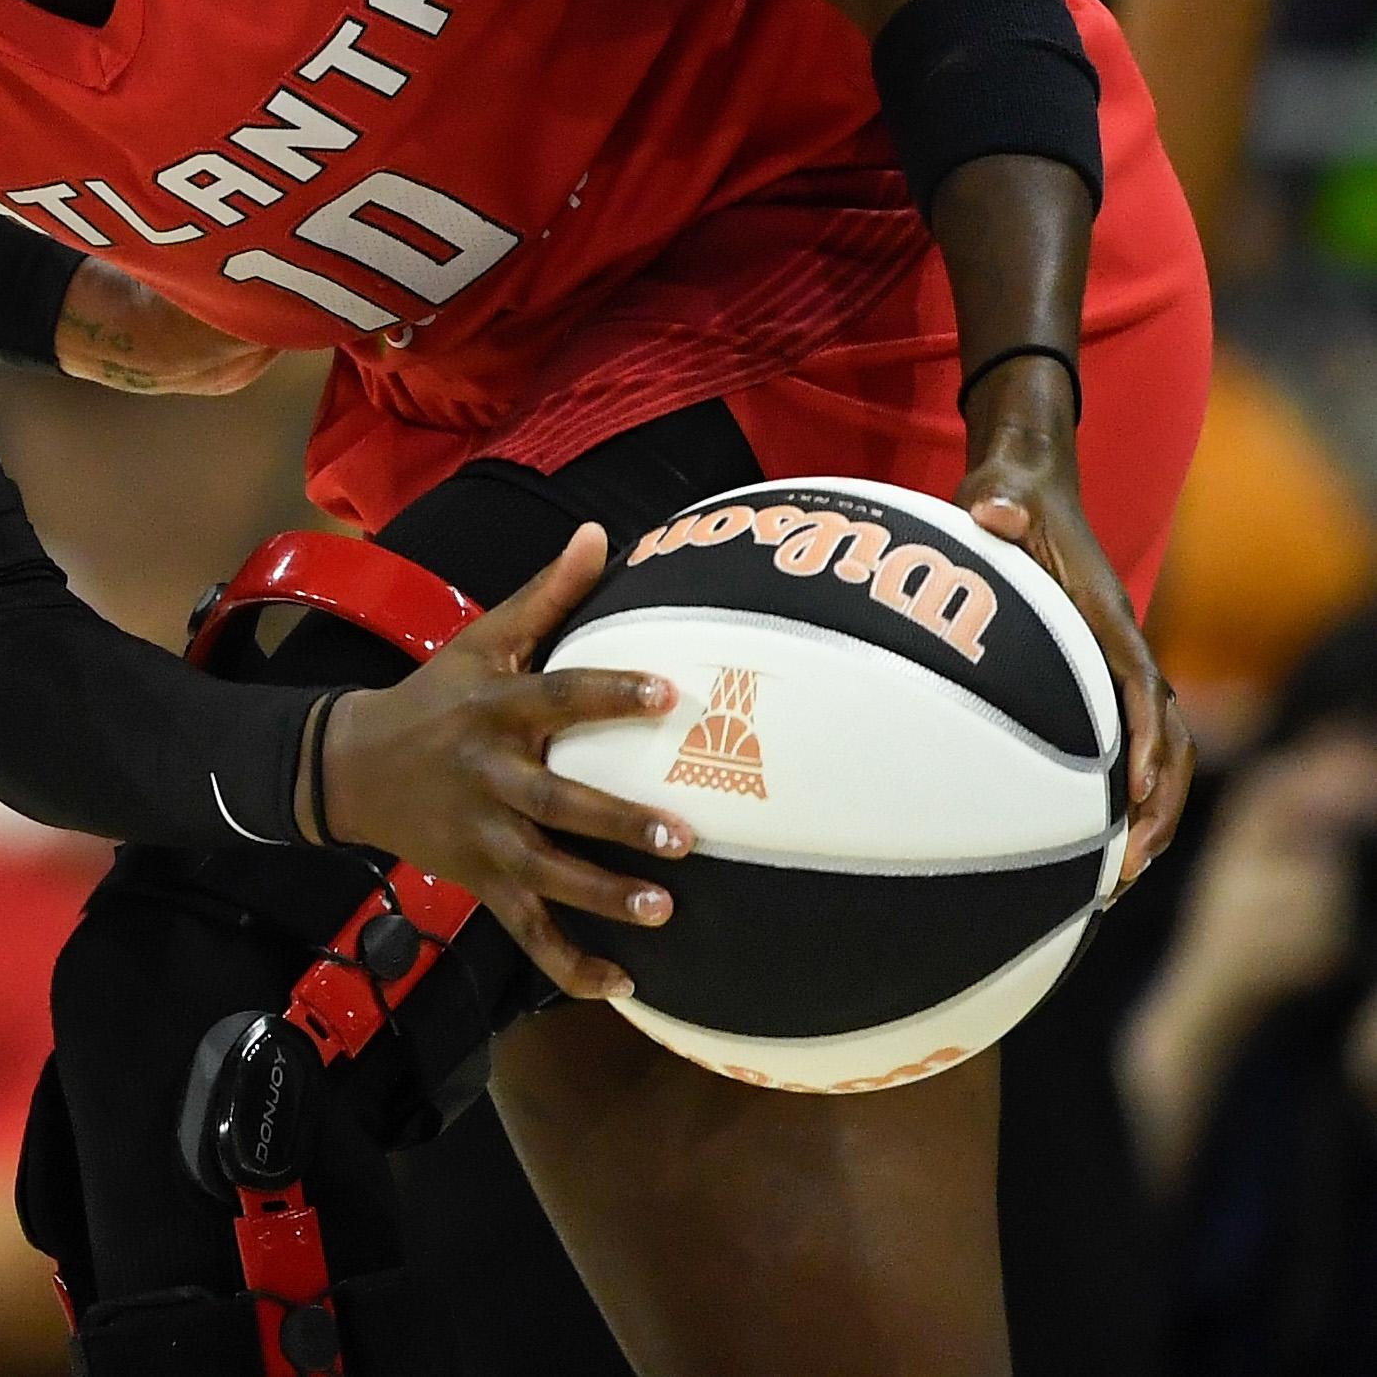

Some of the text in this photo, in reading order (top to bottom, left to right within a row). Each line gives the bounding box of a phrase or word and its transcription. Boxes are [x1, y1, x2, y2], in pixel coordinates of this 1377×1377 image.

[223, 170, 522, 332] 10
[625, 504, 1000, 665] Wilson
[255, 1046, 287, 1165] DONJOY
